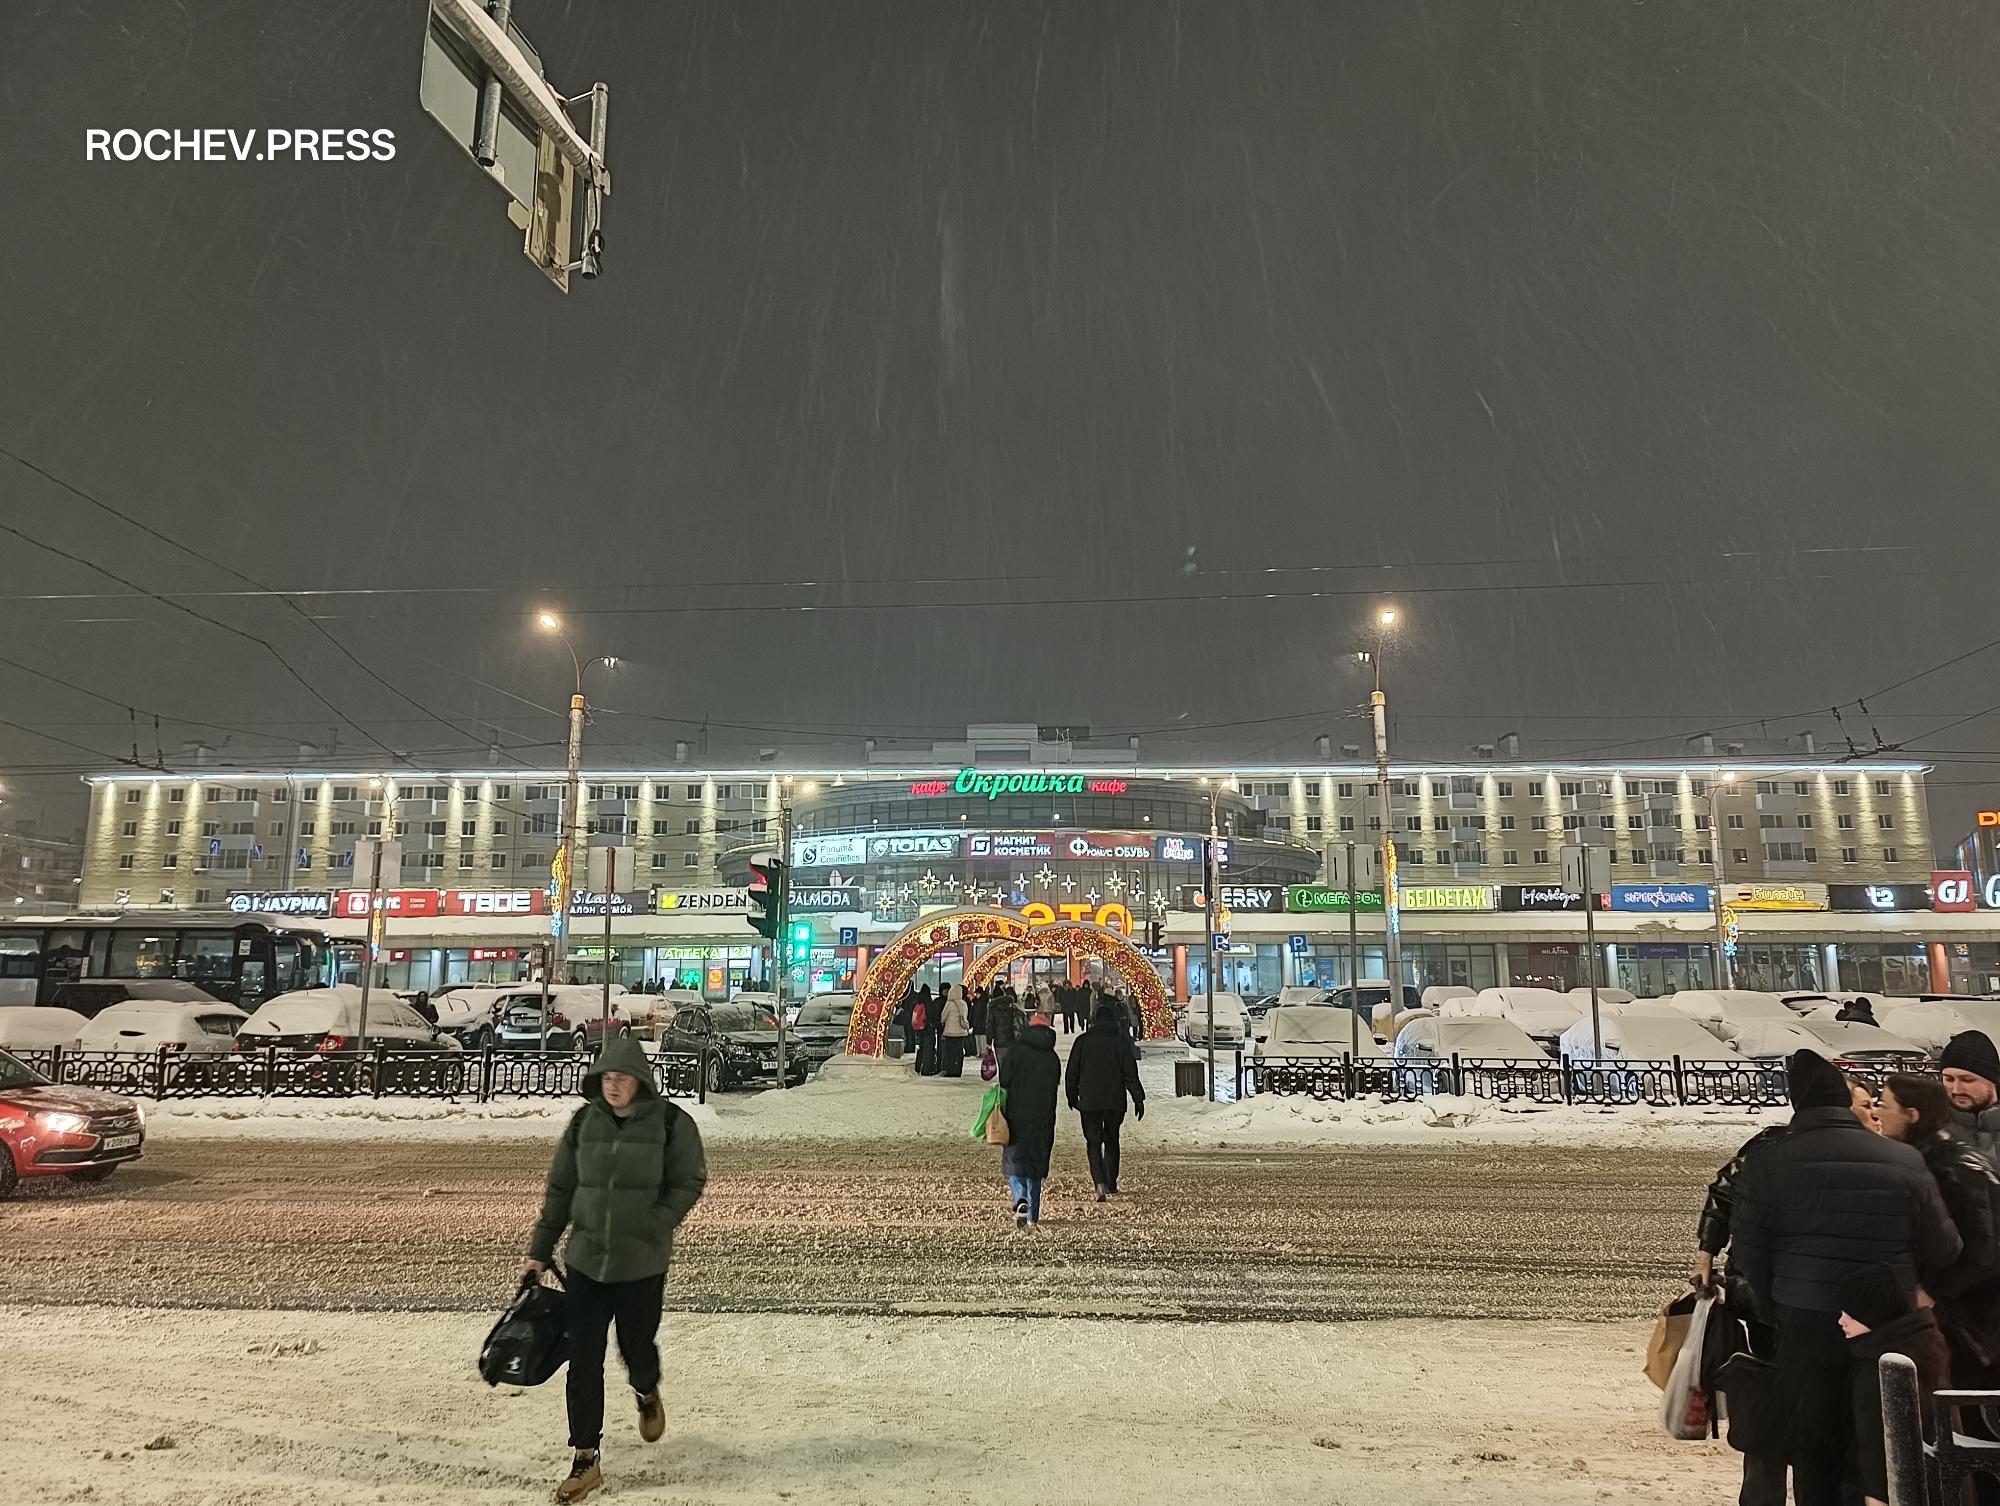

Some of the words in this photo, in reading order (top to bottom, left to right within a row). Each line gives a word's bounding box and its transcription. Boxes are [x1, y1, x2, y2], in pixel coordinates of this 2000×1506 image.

[911, 780, 947, 796] кафе
[954, 767, 1084, 800] Окрошка
[1091, 779, 1127, 795] кафе
[889, 836, 952, 853] ТОПАЗ
[994, 836, 1036, 845] МАГНИТ
[994, 847, 1052, 856] КОСМЕТИК
[1115, 844, 1150, 858] ОБУВЬ
[458, 891, 531, 913] ТВОЕ
[678, 894, 747, 908] ZENDEN
[1405, 888, 1488, 909] БЕЛЬЕТАЖ
[569, 905, 596, 914] АЛОН
[600, 904, 633, 914] СМОК
[665, 948, 720, 959] АПТЕКА
